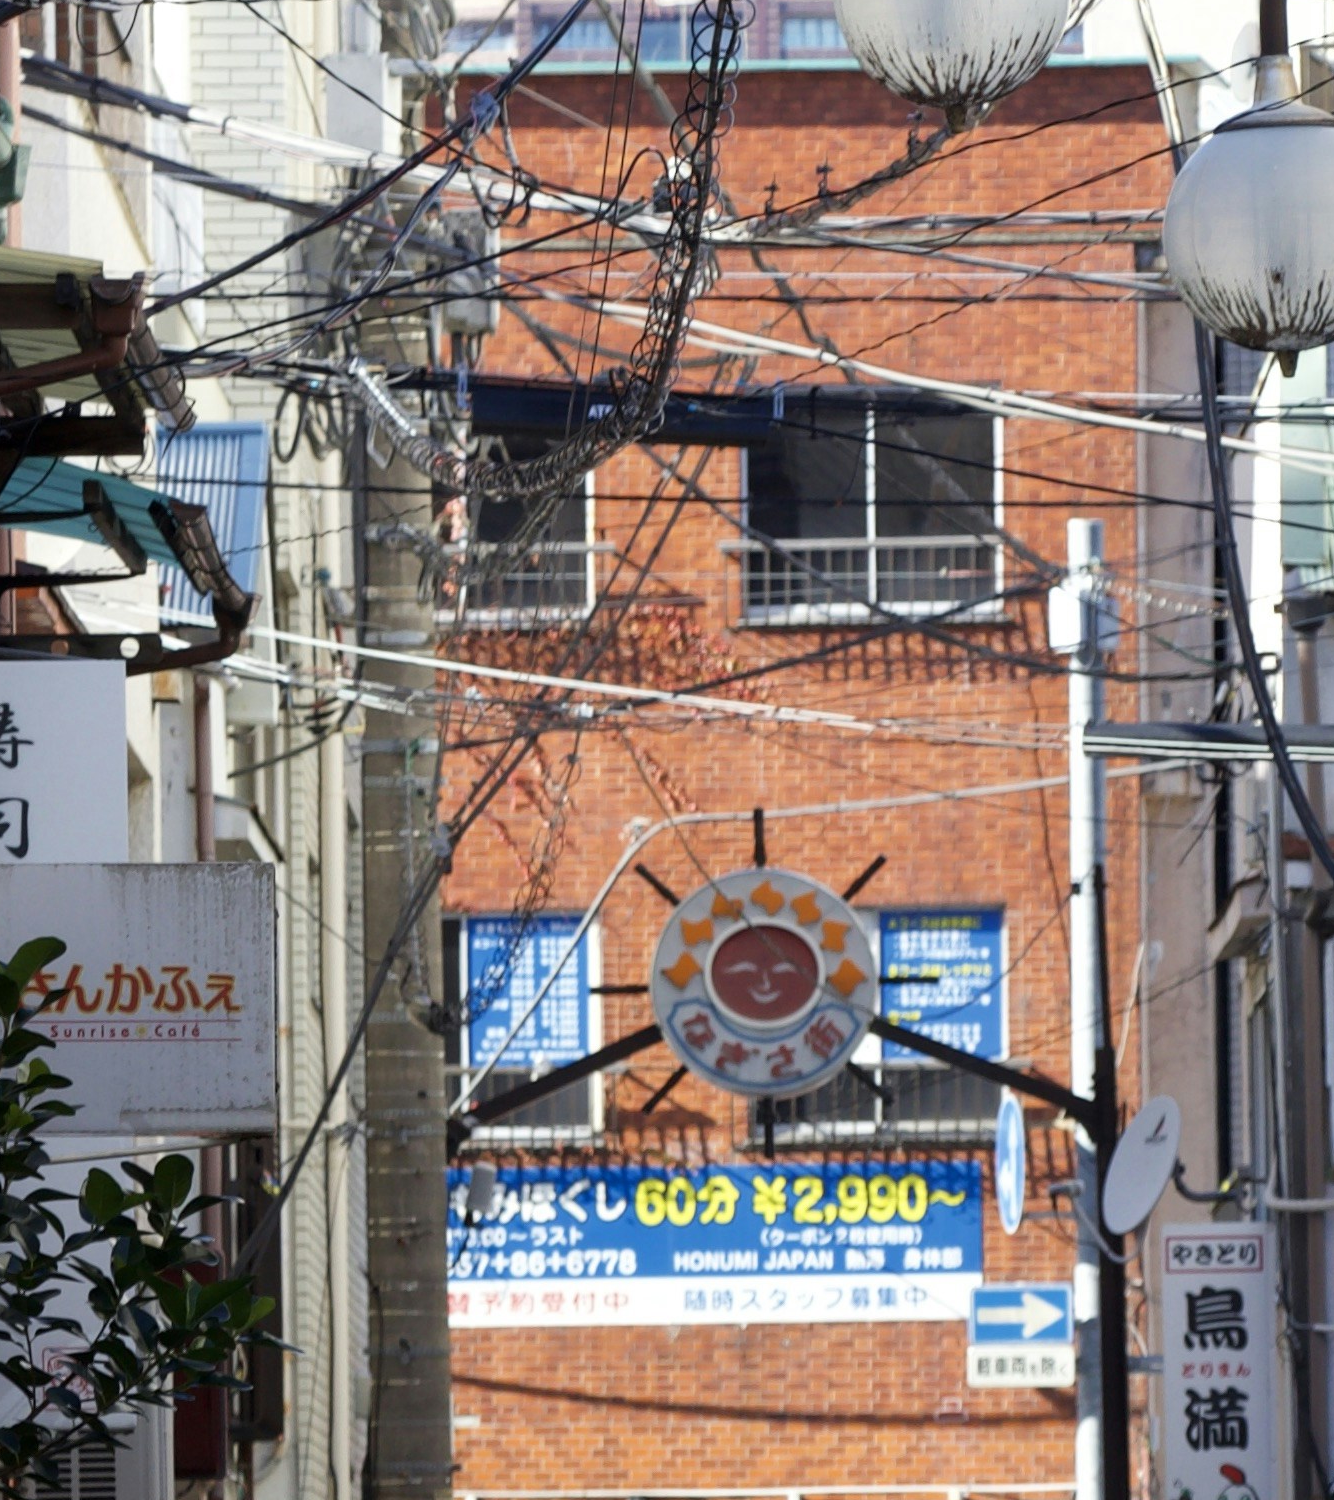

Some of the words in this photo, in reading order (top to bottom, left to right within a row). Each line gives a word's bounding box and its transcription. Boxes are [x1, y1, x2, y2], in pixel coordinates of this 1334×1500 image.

[50, 1024, 130, 1039] Sunrise
[154, 1022, 201, 1039] Café
[682, 1012, 846, 1079] なぎさ街
[635, 1175, 740, 1227] 60分
[674, 1251, 758, 1272] HONUMI
[764, 1250, 834, 1271] JAPAN
[1173, 1243, 1257, 1265] やきとり
[684, 1286, 927, 1312] 随時スタッフ募集中
[1181, 1362, 1251, 1378] とりまん
